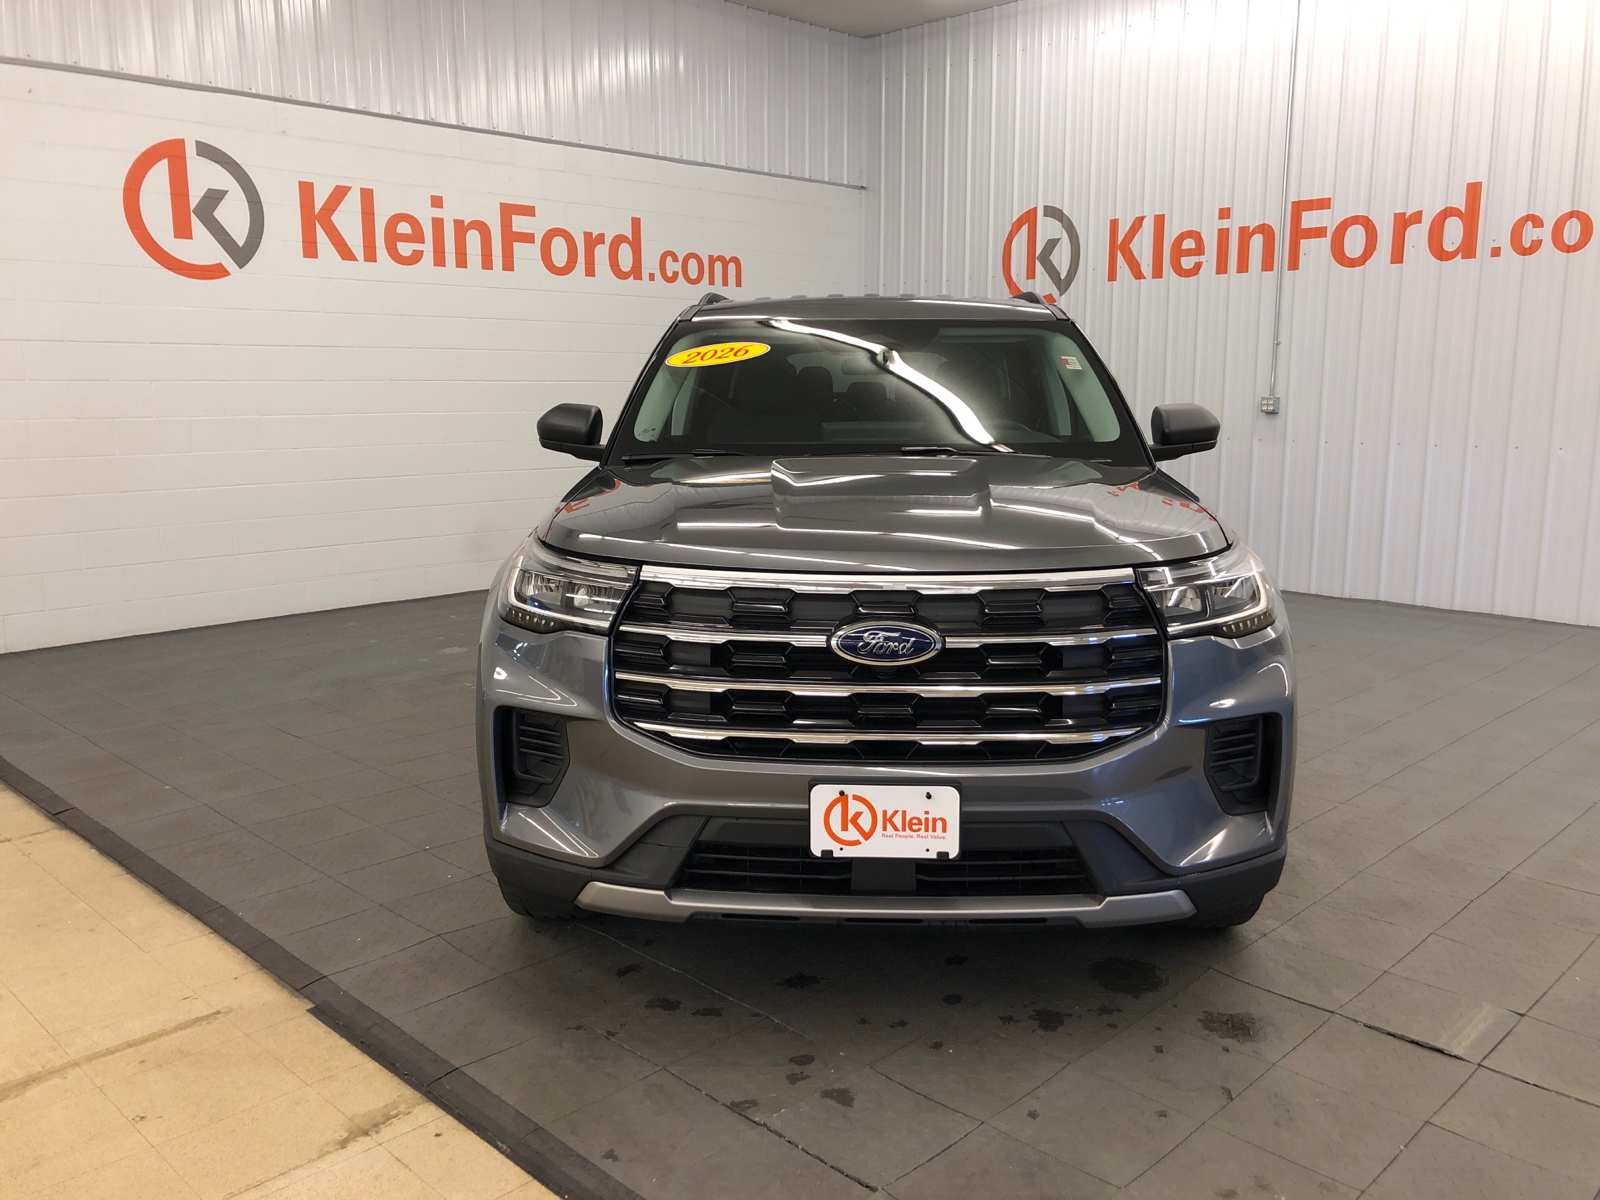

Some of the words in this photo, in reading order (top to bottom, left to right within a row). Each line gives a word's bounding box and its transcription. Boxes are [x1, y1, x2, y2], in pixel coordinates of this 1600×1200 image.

[297, 180, 742, 288] KleinFord.com
[1107, 181, 1594, 283] KleinFord.co
[682, 345, 754, 365] 2026
[857, 630, 915, 655] Ford
[881, 809, 948, 834] Klein
